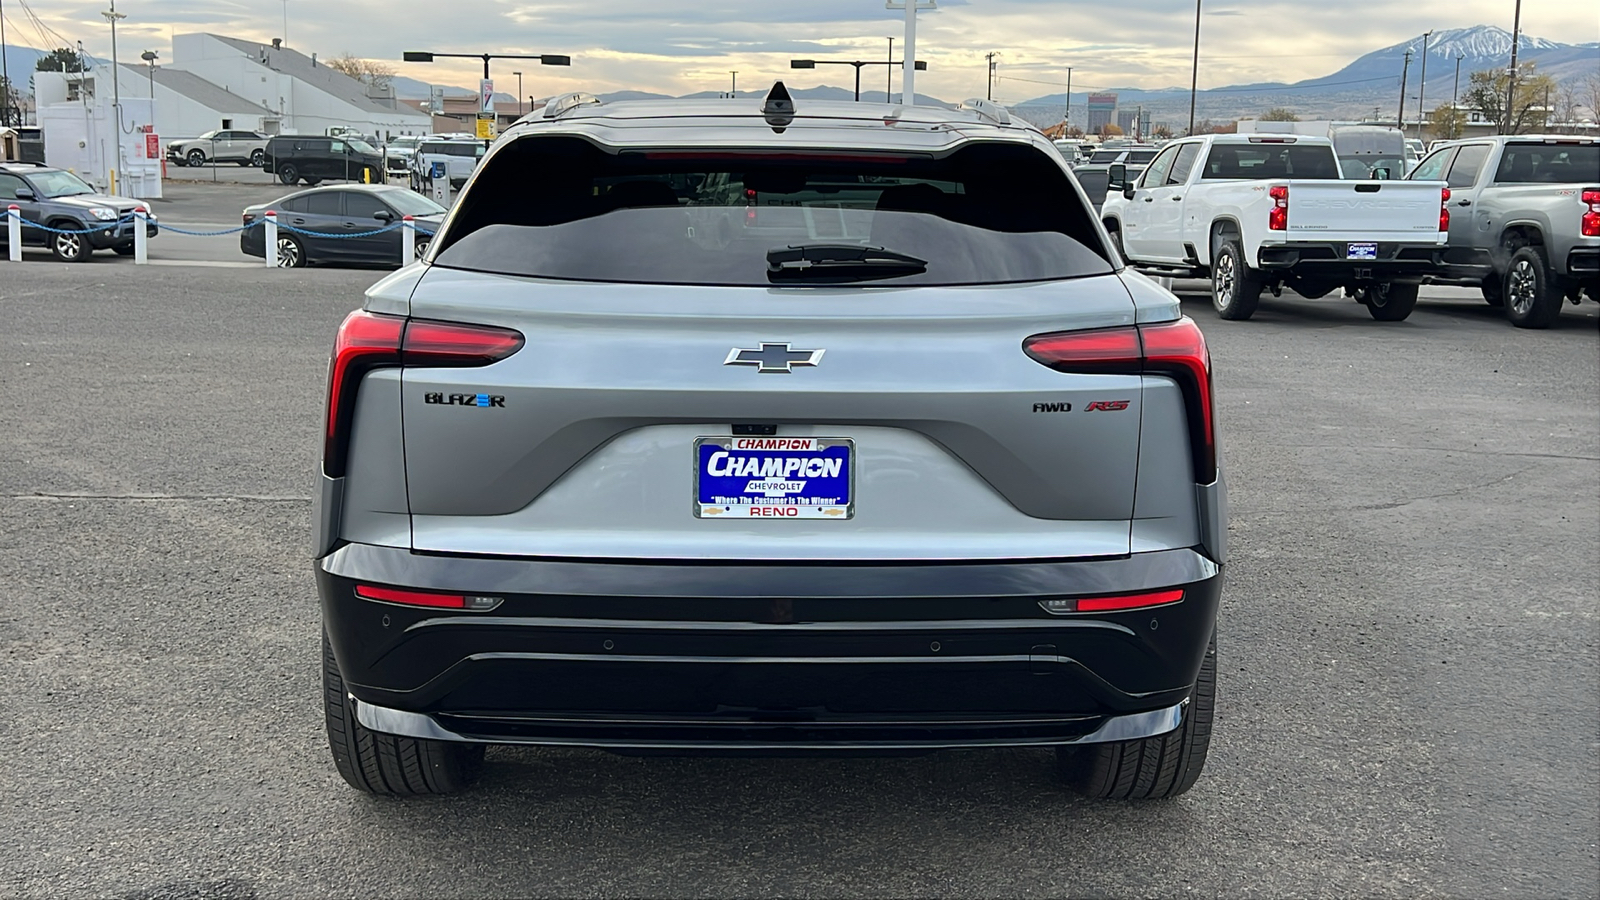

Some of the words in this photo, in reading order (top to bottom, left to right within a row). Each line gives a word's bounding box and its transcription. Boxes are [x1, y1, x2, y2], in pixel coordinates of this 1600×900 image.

[424, 391, 506, 408] BLAZER
[1033, 402, 1072, 413] AWD
[1083, 400, 1131, 412] RS
[737, 439, 811, 450] CHAMPION
[707, 451, 843, 478] CHAMPION
[748, 482, 801, 491] CHEVROLET
[739, 496, 752, 504] The
[754, 496, 787, 504] Customer
[797, 496, 810, 504] The
[749, 507, 798, 517] RENO
